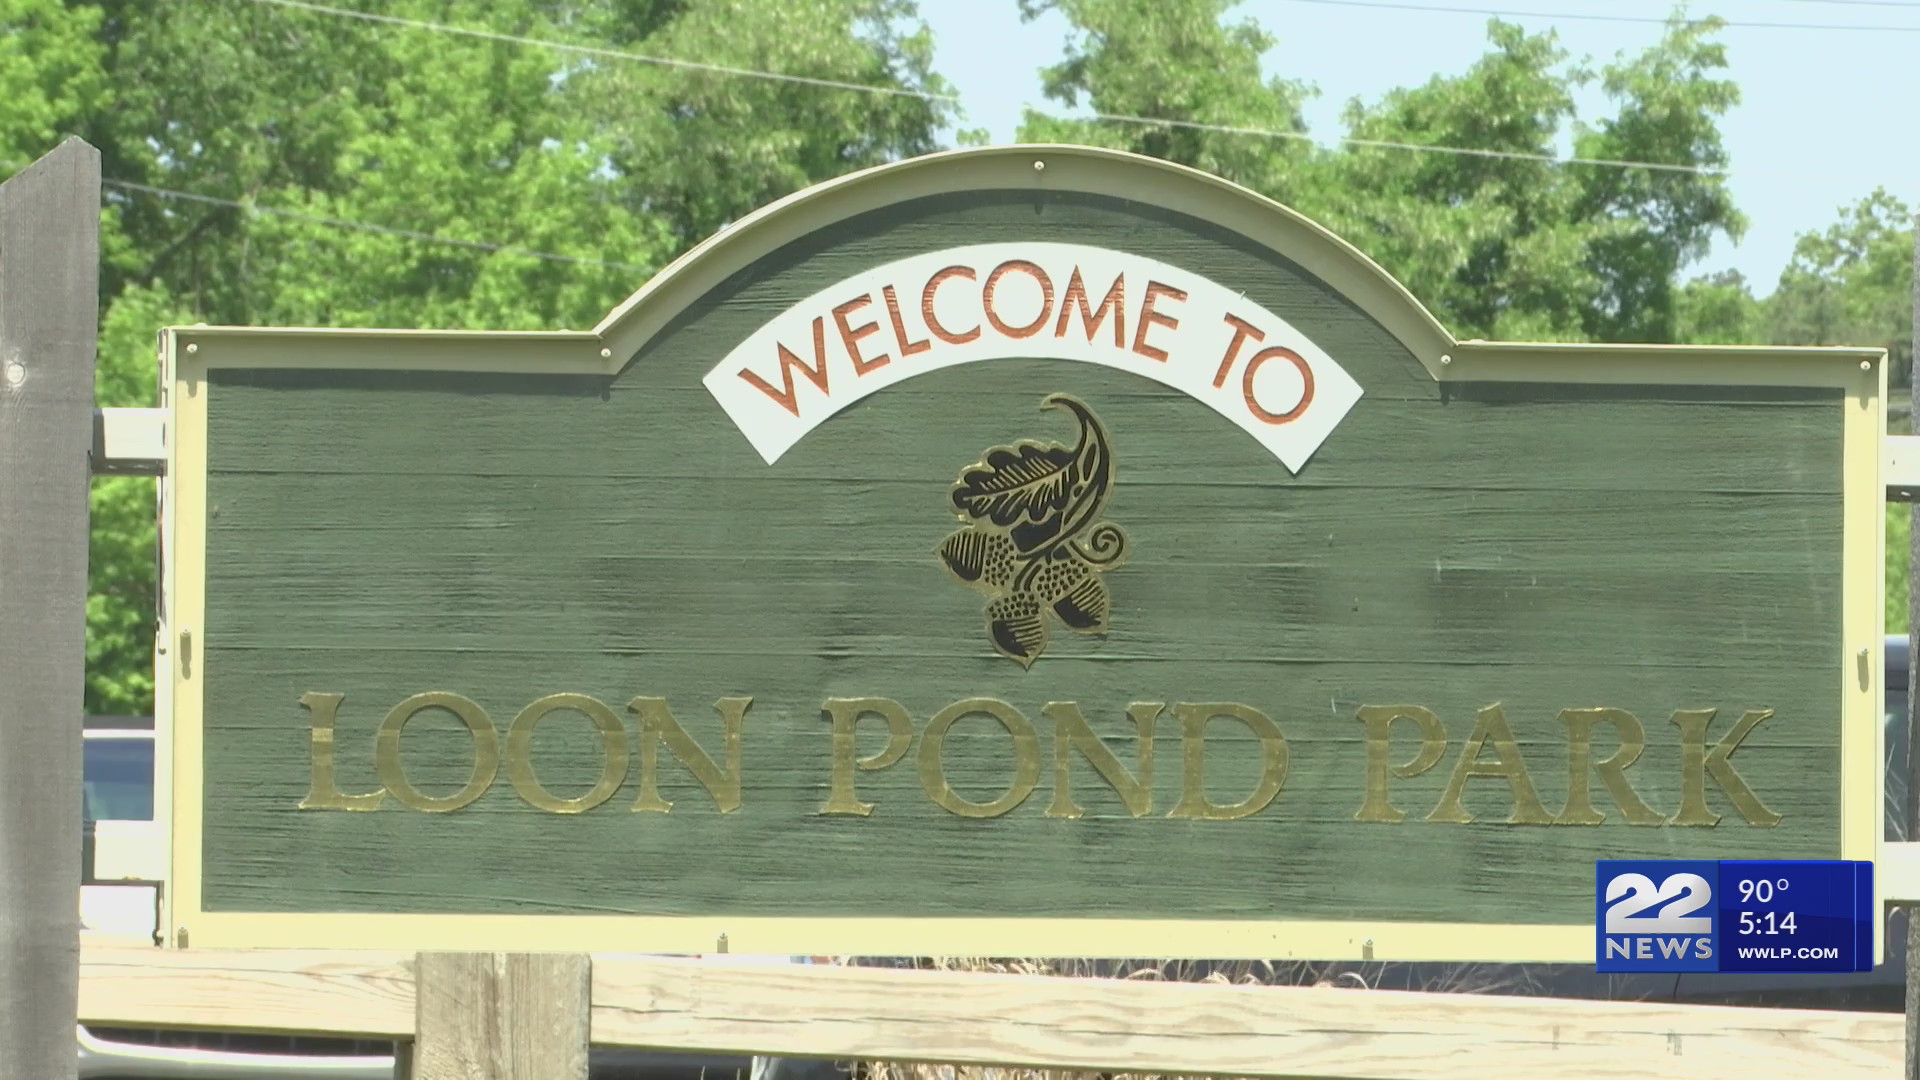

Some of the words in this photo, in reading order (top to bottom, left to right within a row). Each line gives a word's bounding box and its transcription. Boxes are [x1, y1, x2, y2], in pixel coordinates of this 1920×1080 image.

[737, 259, 1189, 418] WELCOME
[1212, 312, 1315, 425] TO
[298, 691, 754, 814] LOON
[819, 697, 1289, 820] POND
[1354, 701, 1783, 826] PARK
